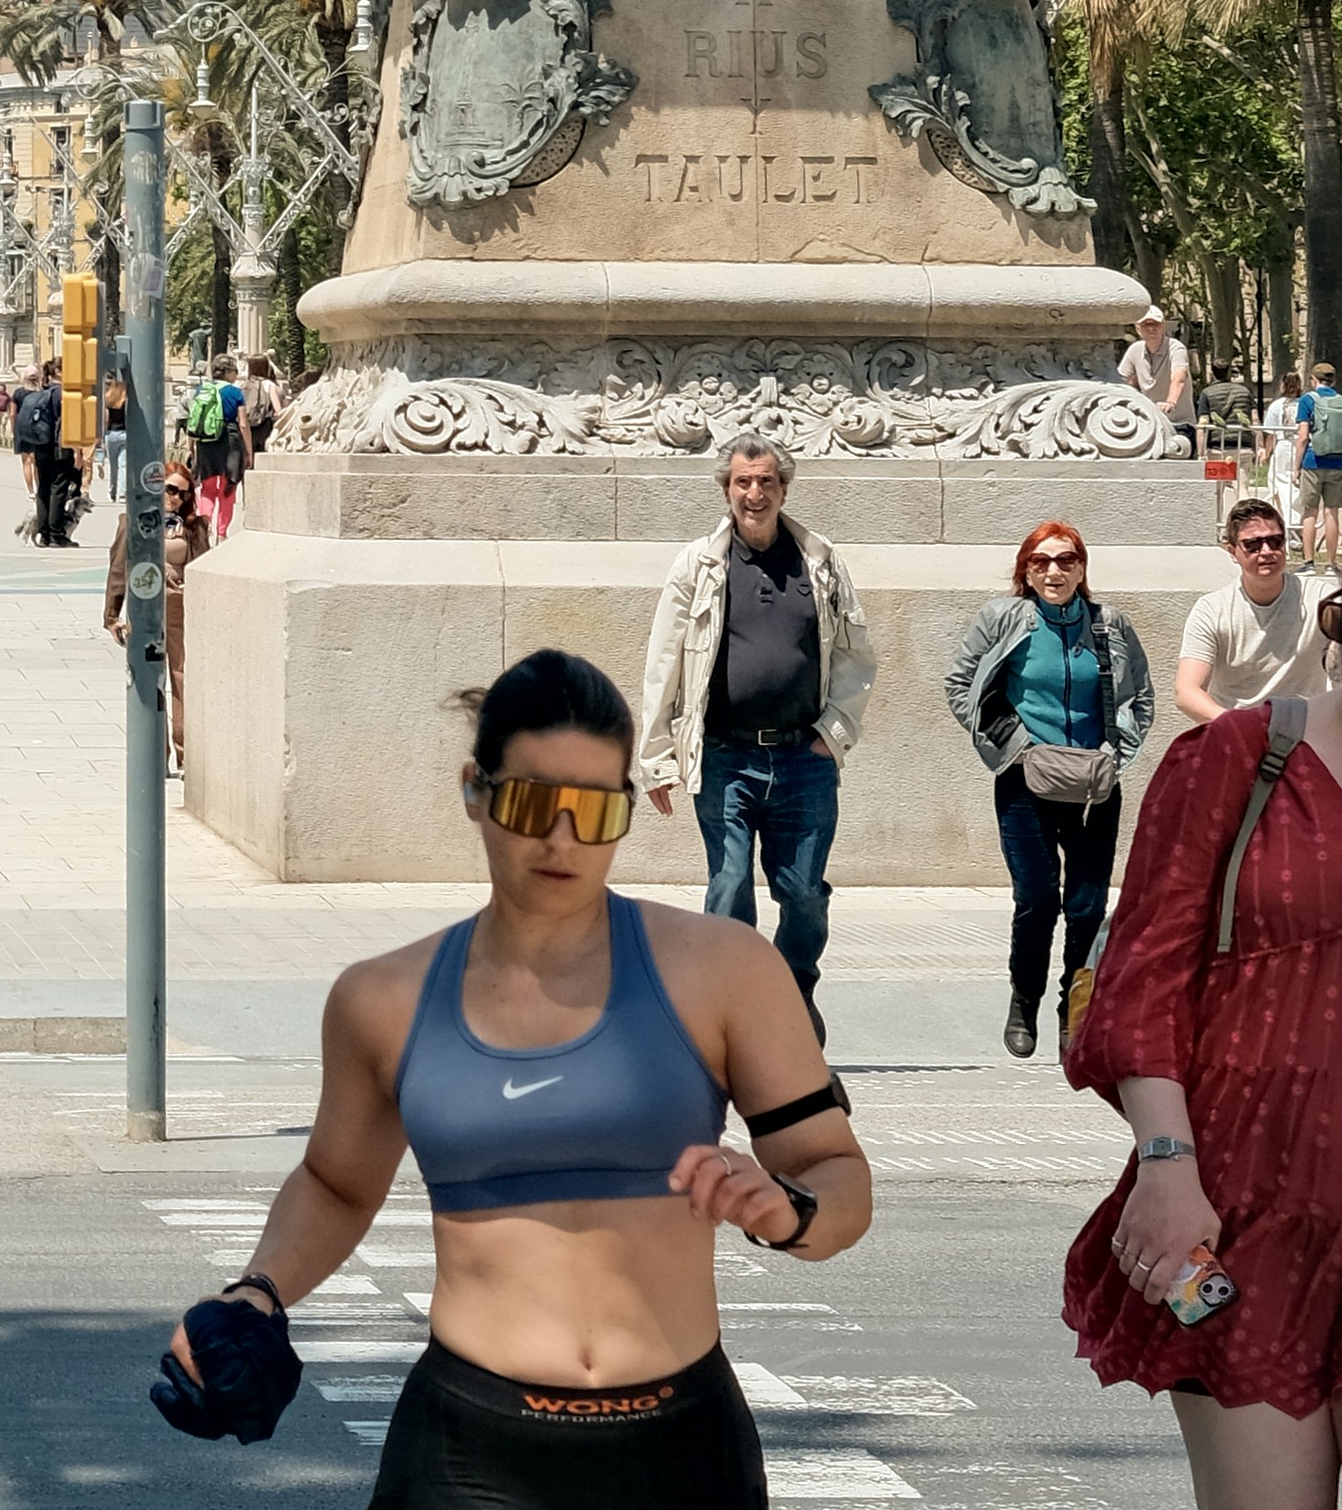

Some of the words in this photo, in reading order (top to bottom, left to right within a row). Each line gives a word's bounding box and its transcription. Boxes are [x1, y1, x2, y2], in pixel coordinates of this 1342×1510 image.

[683, 29, 828, 79] RIUS
[739, 97, 772, 135] Y
[634, 153, 878, 204] TAULET
[521, 1408, 663, 1423] PERFORMANCE
[524, 1395, 659, 1414] WONG
